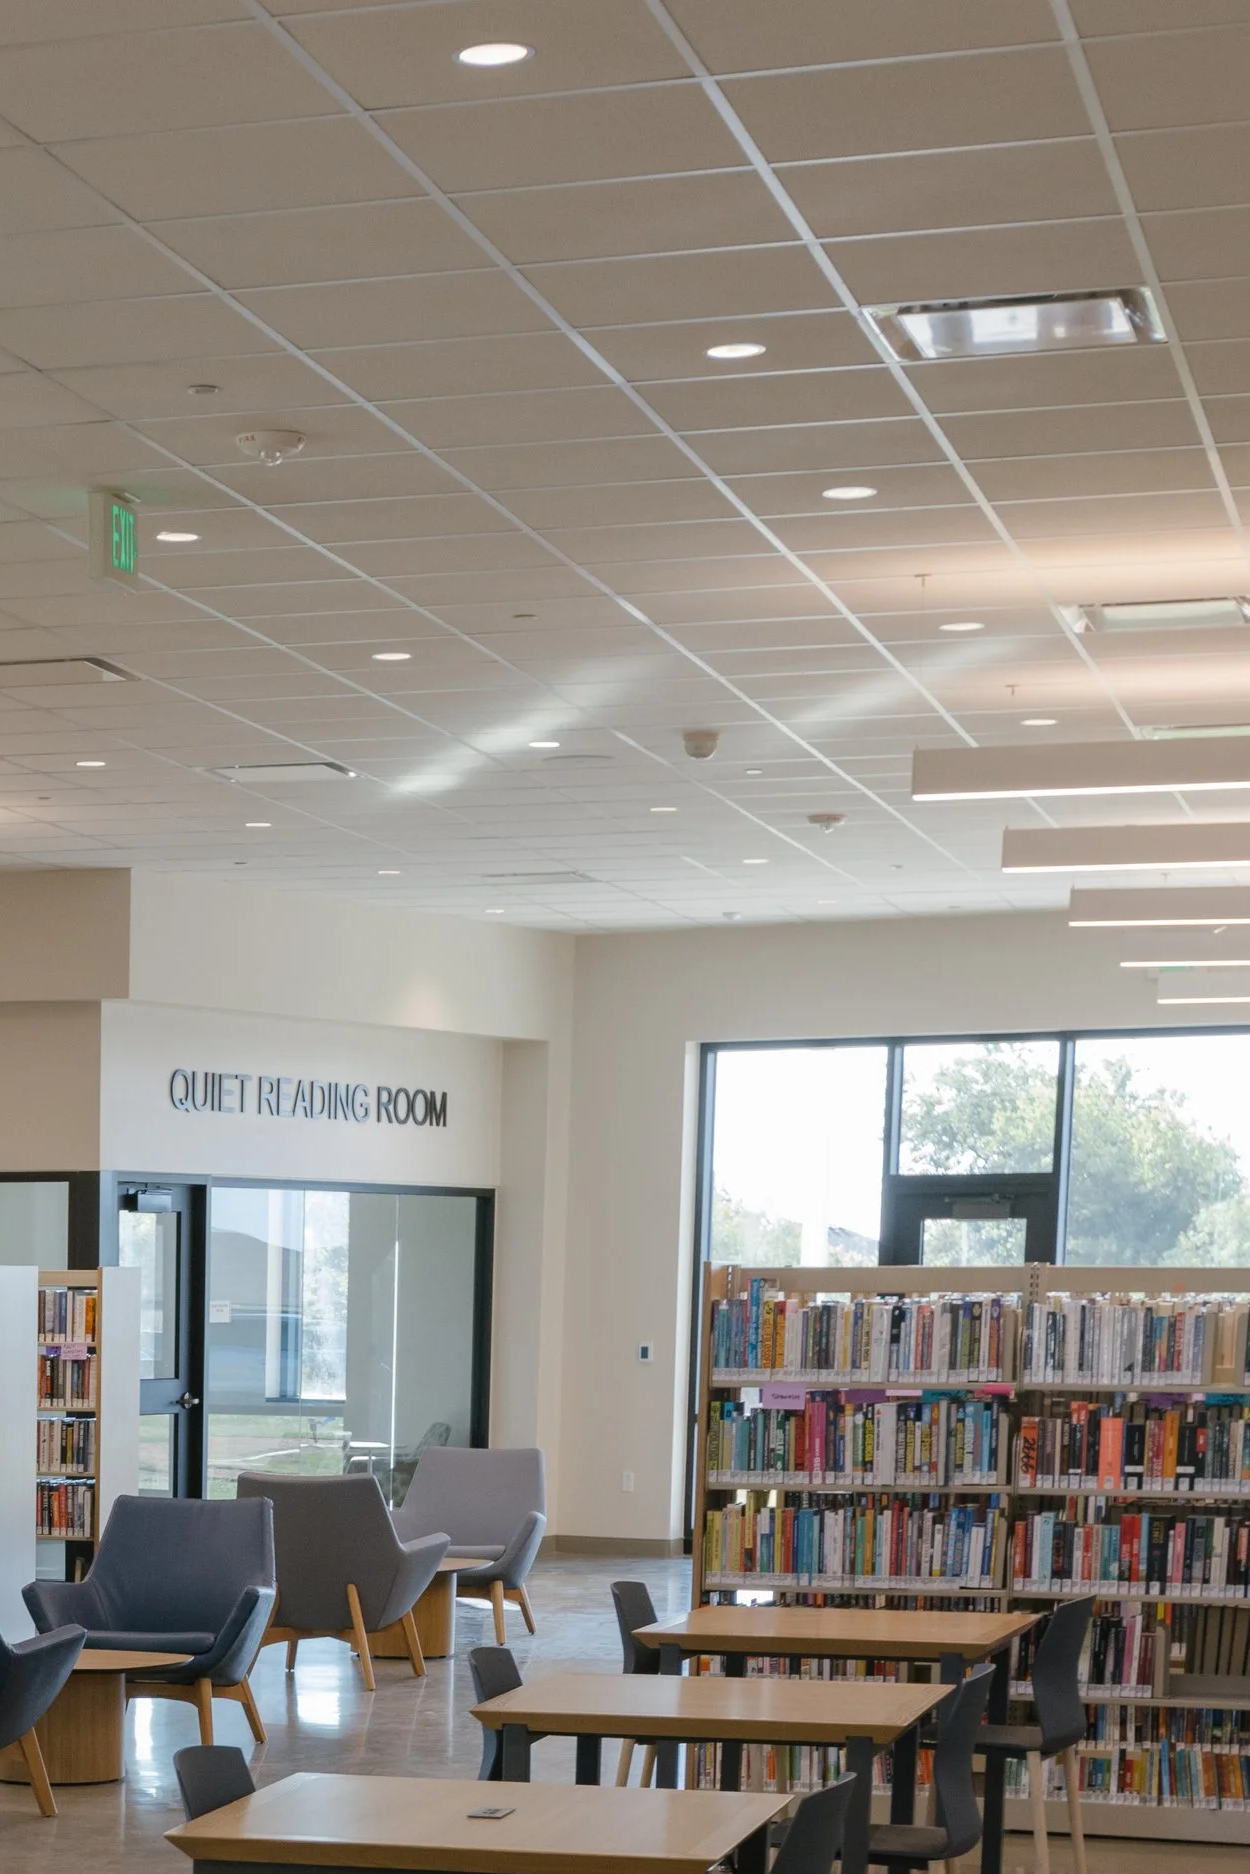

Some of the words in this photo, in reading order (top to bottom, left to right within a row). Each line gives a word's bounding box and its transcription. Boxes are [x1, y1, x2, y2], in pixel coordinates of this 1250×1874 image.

[112, 504, 135, 575] EXIT
[170, 1068, 252, 1113] QUIET
[257, 1076, 371, 1122] READING
[376, 1085, 448, 1127] ROOM
